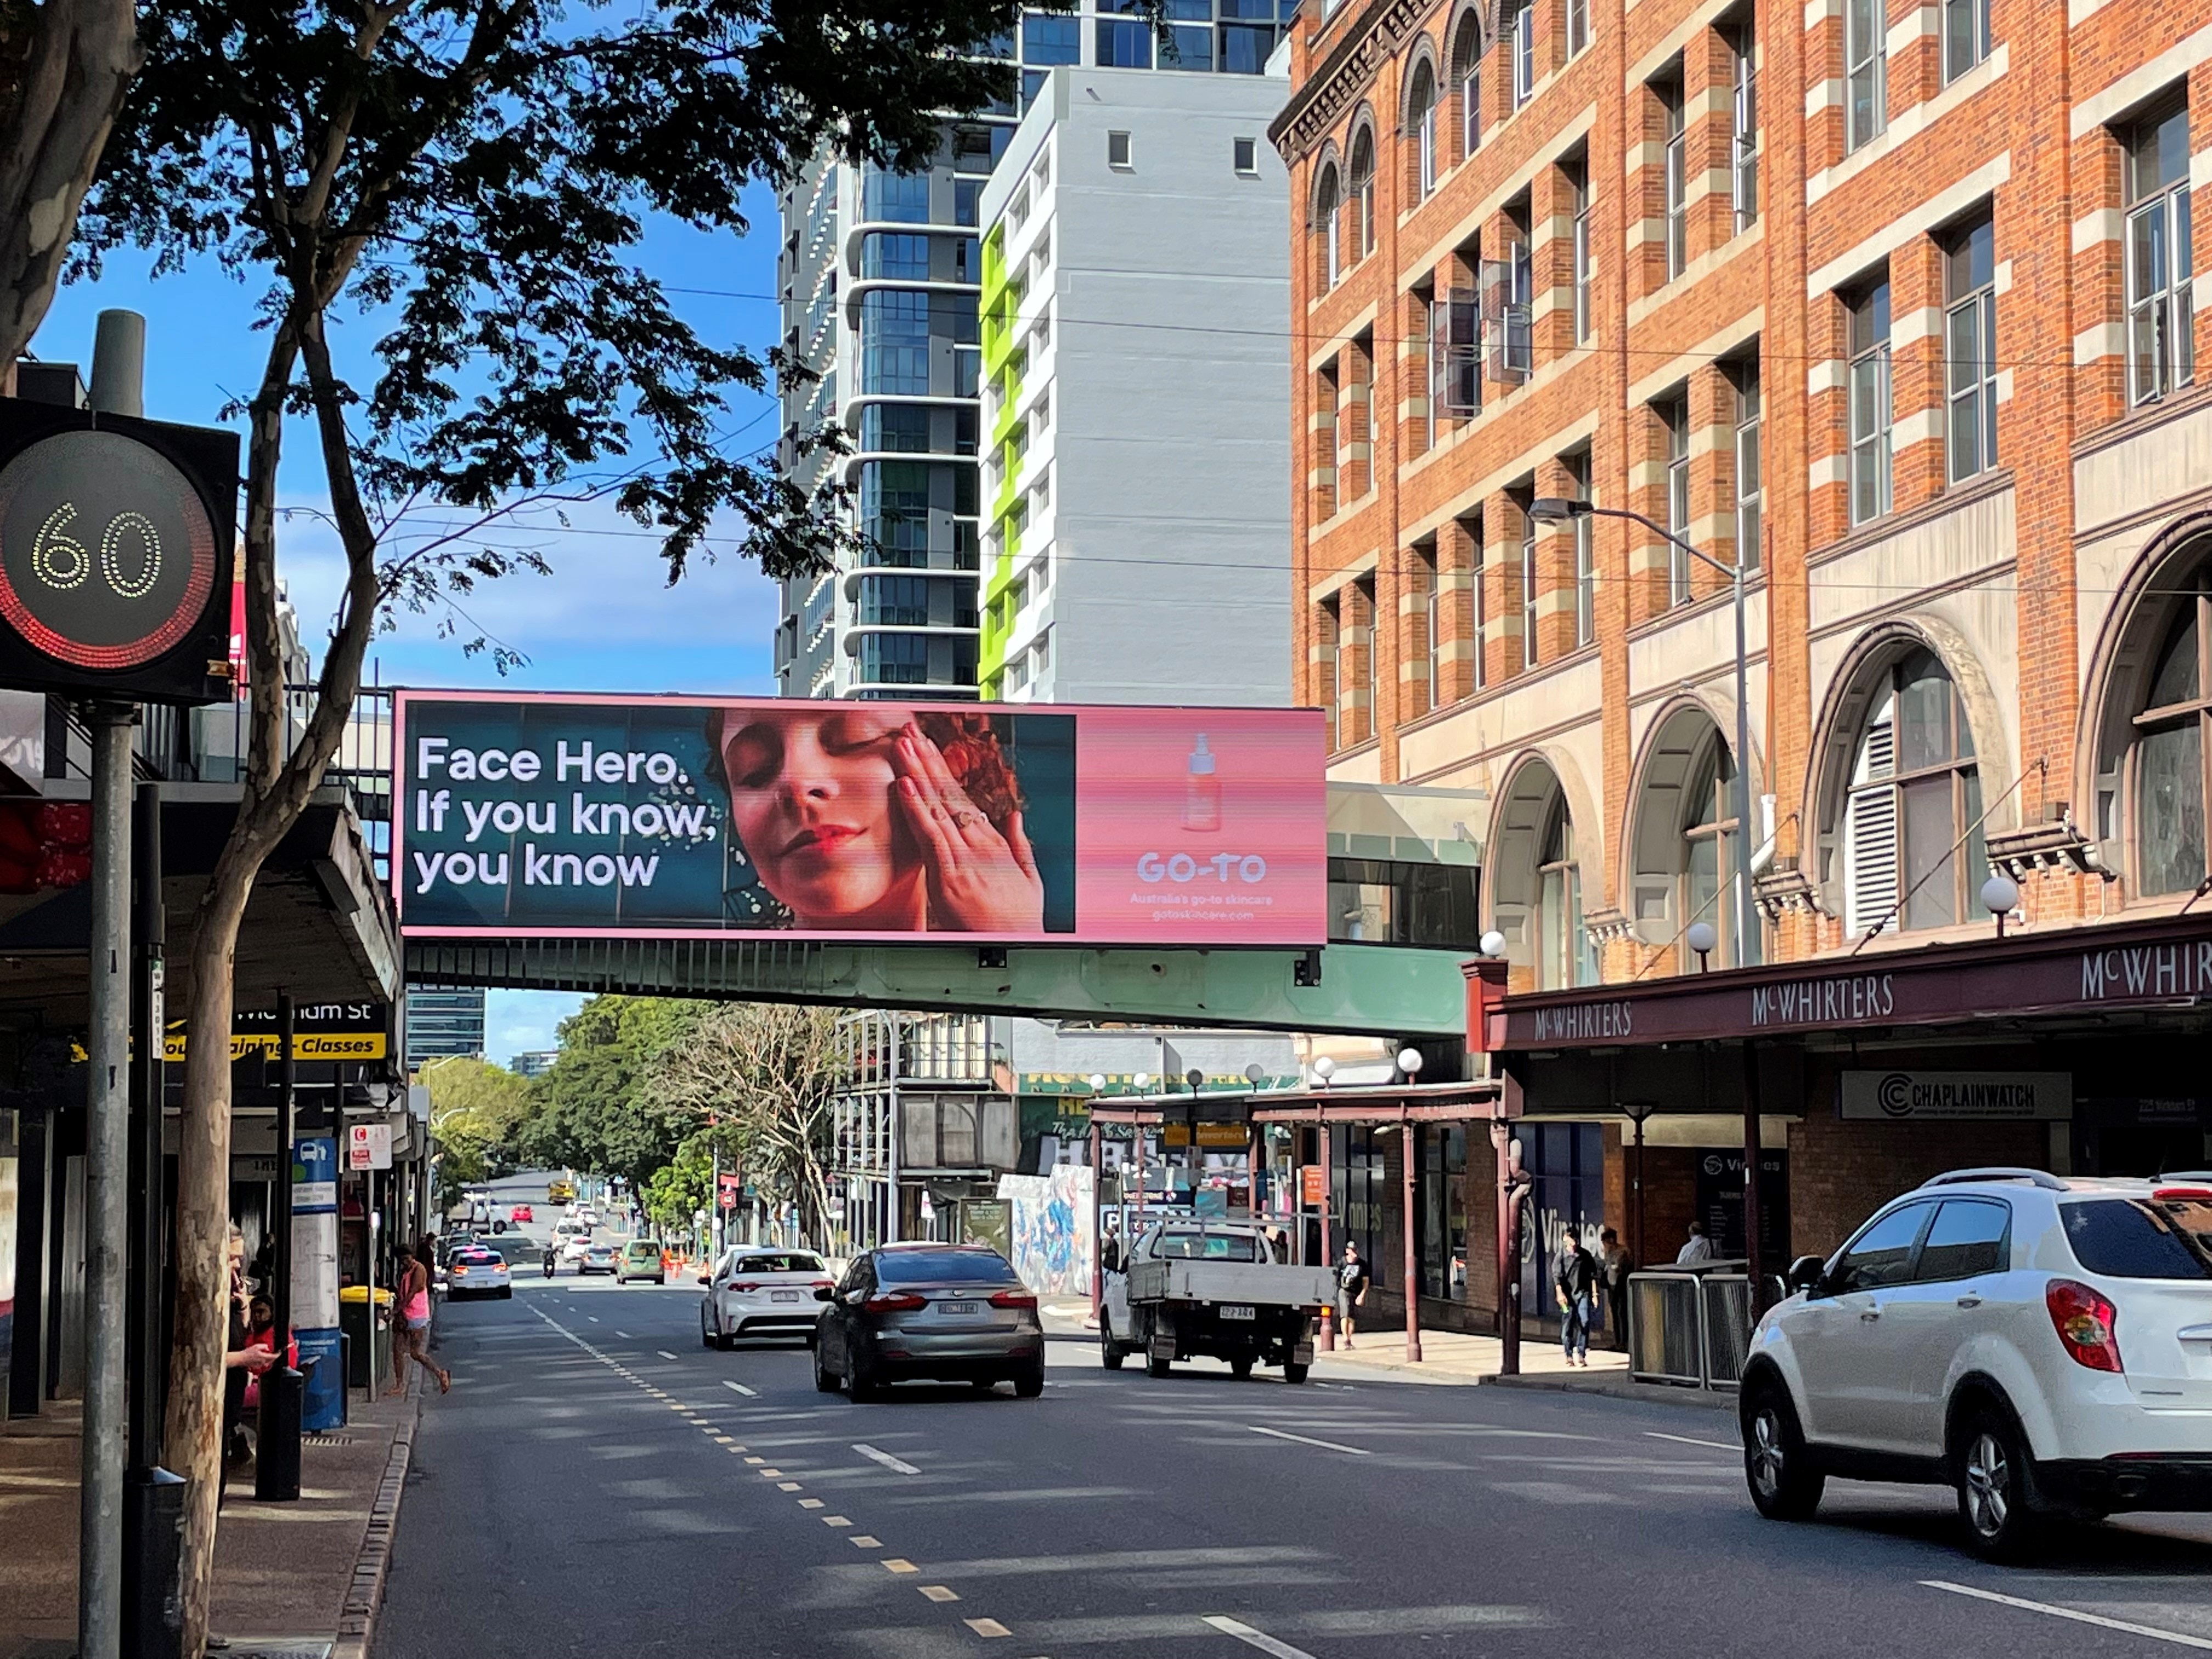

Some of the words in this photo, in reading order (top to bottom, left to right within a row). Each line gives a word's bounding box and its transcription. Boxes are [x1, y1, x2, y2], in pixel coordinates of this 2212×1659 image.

[31, 500, 162, 600] 60
[416, 737, 541, 781] Face
[556, 740, 689, 784] Hero.
[416, 788, 450, 832] If
[461, 800, 556, 843] you
[572, 792, 717, 842] know,
[413, 851, 508, 894] you
[524, 843, 659, 887] know
[1137, 851, 1267, 883] GO-TO
[1130, 892, 1189, 905] Australia's
[1190, 895, 1222, 906] go-to
[1225, 893, 1273, 905] skincare
[1152, 909, 1255, 922] gotoskincare.com
[347, 1003, 371, 1019] St
[302, 1037, 374, 1053] Classes
[1912, 1083, 2035, 1107] CHAPLAINWATCH
[1726, 1158, 1780, 1171] Vinies
